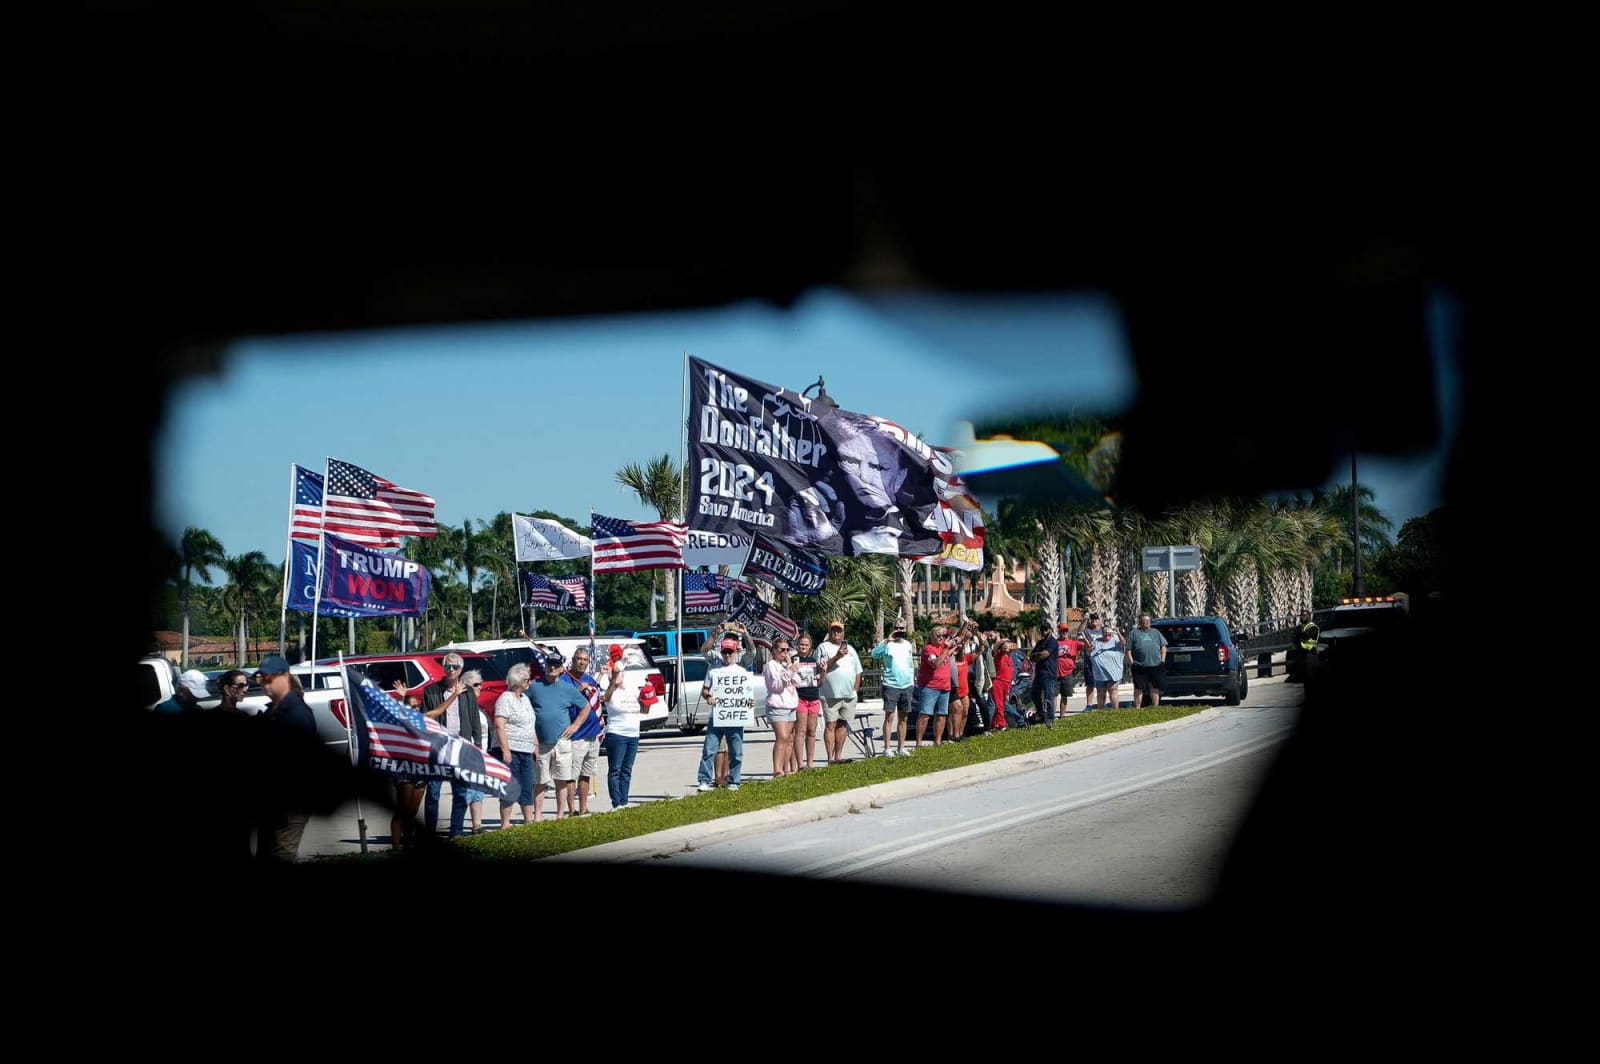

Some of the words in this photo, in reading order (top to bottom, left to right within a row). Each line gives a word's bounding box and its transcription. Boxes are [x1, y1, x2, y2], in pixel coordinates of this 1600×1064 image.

[704, 368, 749, 413] The
[700, 404, 827, 468] Donfather
[700, 457, 775, 506] 2024
[699, 495, 729, 517] Save
[730, 500, 775, 527] America
[688, 533, 750, 550] REEDOM
[336, 549, 419, 579] TRUMP
[751, 548, 826, 590] FREEDOM
[347, 574, 406, 602] WON
[717, 675, 748, 686] KEEP
[724, 686, 744, 695] OUR
[713, 697, 755, 709] PRESIDEN
[718, 710, 748, 721] SAFE
[369, 756, 452, 777] CHARLIE
[454, 767, 509, 796] KIRK
